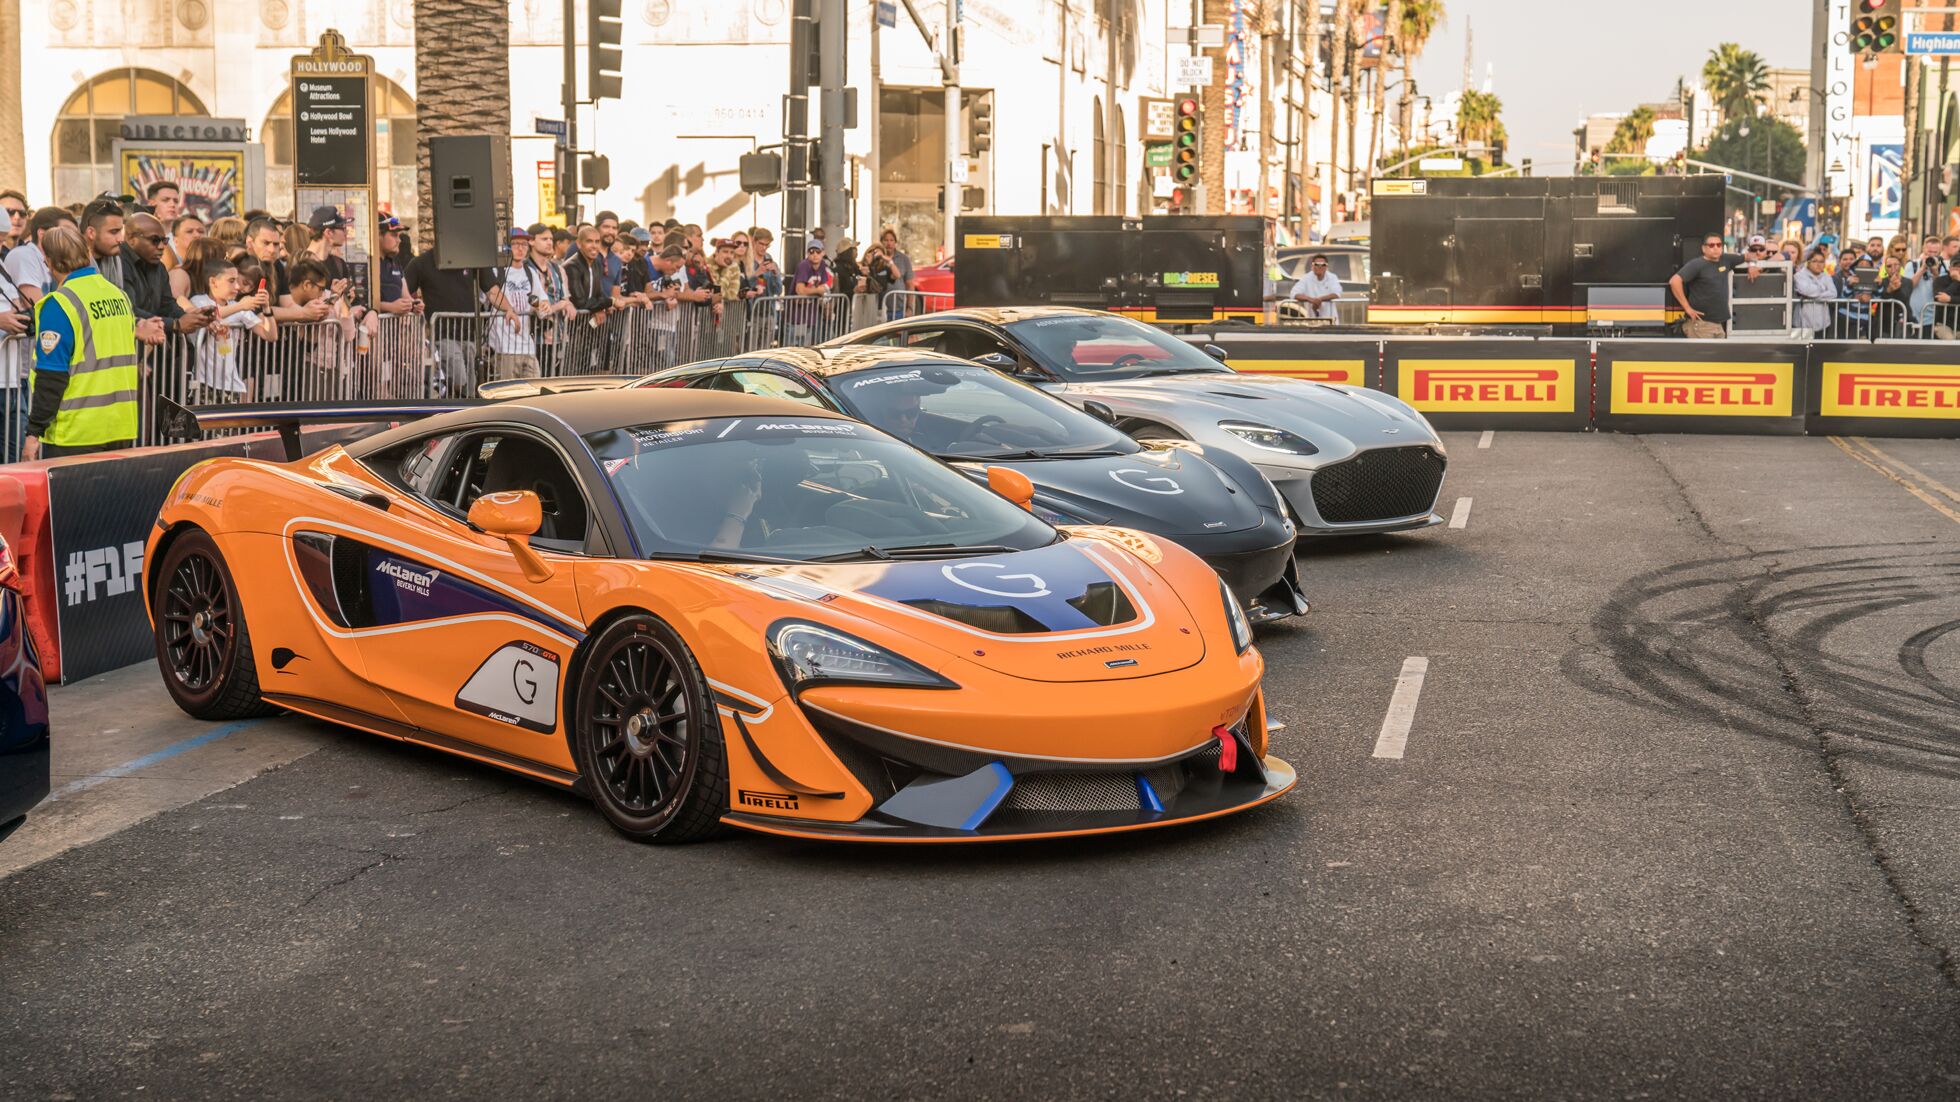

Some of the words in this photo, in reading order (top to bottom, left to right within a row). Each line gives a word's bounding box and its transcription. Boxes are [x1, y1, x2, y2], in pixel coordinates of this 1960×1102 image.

[297, 61, 362, 72] HOLLYWOOD
[309, 92, 340, 100] Attractions
[309, 112, 338, 121] Hollywood
[338, 112, 353, 120] Bowl
[120, 124, 251, 141] DIRECTORY
[328, 128, 357, 136] Hollywood
[310, 136, 326, 144] Hotel
[853, 371, 921, 388] McLaren
[1413, 369, 1559, 401] PIRELLI
[1626, 371, 1777, 405] PIRELLI
[755, 423, 853, 431] McLaren
[635, 428, 705, 443] MOTORSPORT
[642, 437, 684, 447] RETAILER
[375, 561, 431, 588] McLaren
[396, 579, 416, 592] BEVERLY
[416, 585, 430, 597] HILLS
[542, 650, 557, 661] GT4
[1056, 646, 1113, 660] RICHARD
[1114, 643, 1152, 652] MILLE
[488, 712, 519, 725] McLaren
[738, 789, 799, 810] PIRELLI
